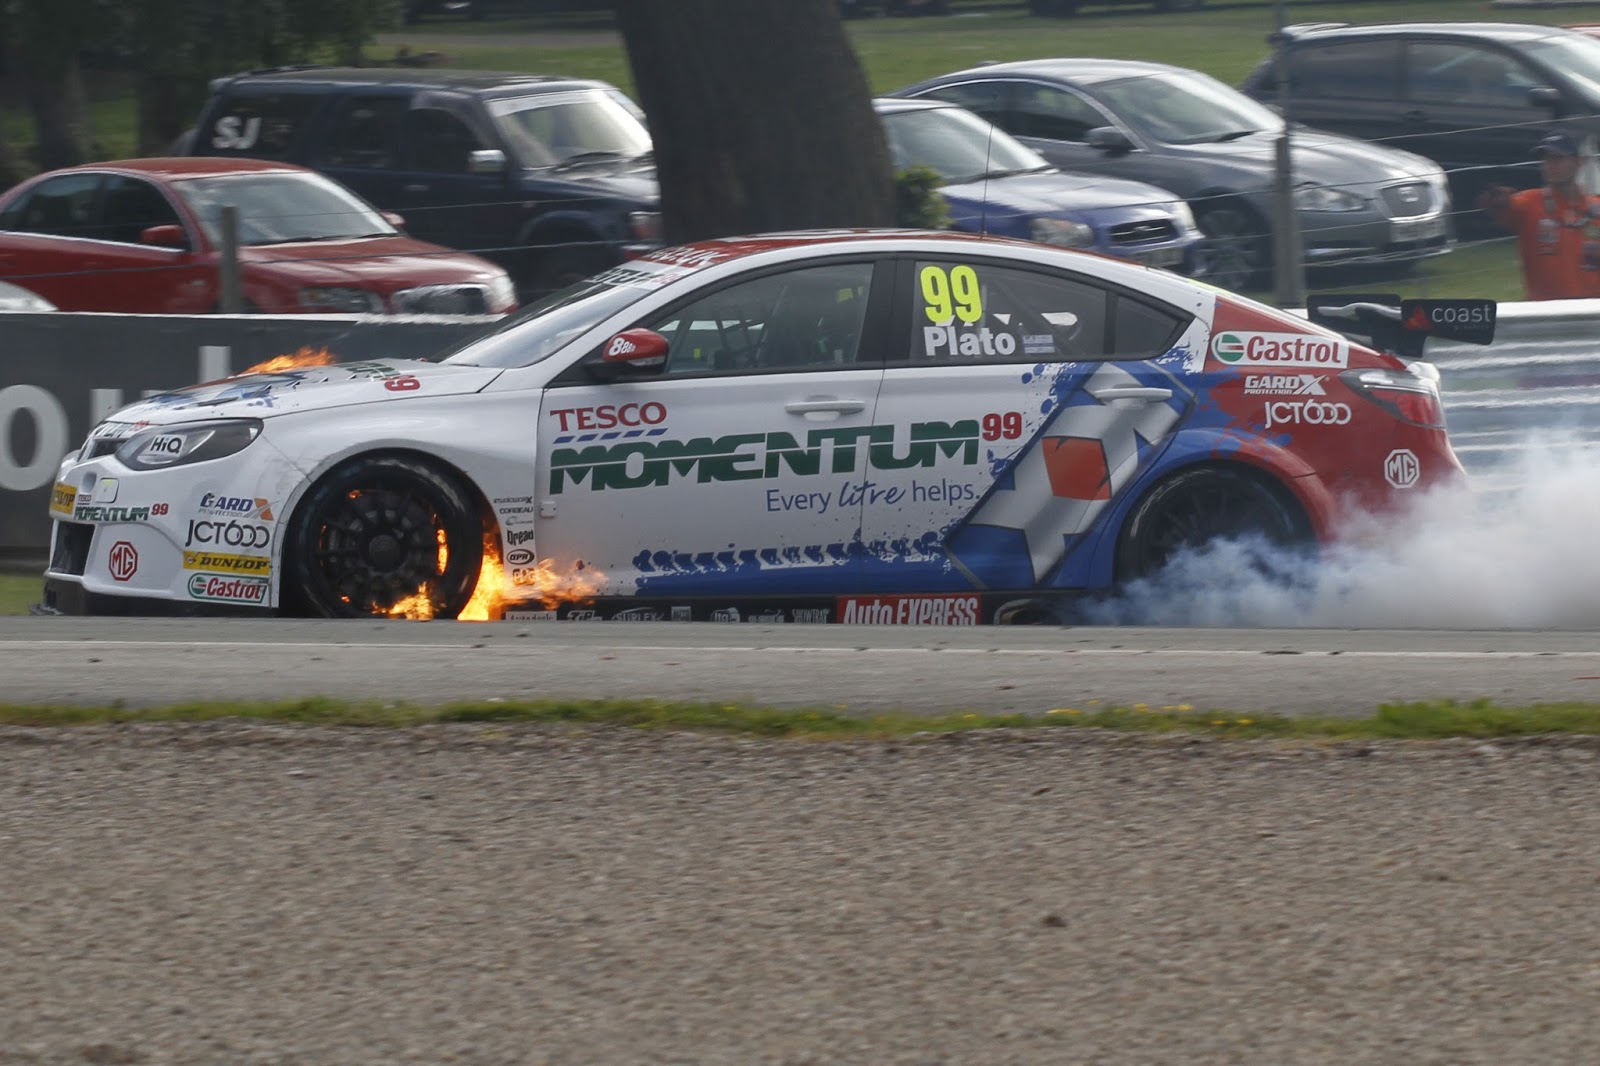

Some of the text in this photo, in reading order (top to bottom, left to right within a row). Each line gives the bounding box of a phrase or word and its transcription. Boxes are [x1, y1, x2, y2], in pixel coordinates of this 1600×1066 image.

[212, 116, 262, 149] SJ
[920, 265, 983, 323] 99
[1432, 305, 1491, 323] coast
[923, 326, 1016, 356] Plato
[1246, 335, 1341, 363] Castrol
[550, 401, 667, 432] TESCO
[1264, 398, 1352, 429] JCT600
[151, 437, 182, 454] HiQ
[549, 411, 1022, 495] MOMENTUM 99
[1388, 454, 1416, 483] MG
[766, 478, 980, 514] Every litre helps.
[74, 503, 169, 522] MOMENTUM 99
[185, 520, 270, 548] JCT600
[507, 530, 534, 546] Dread
[111, 545, 137, 577] MG
[200, 555, 269, 570] DUNLOP
[206, 577, 263, 600] Castrol
[844, 598, 978, 626] Auto EXPRESS
